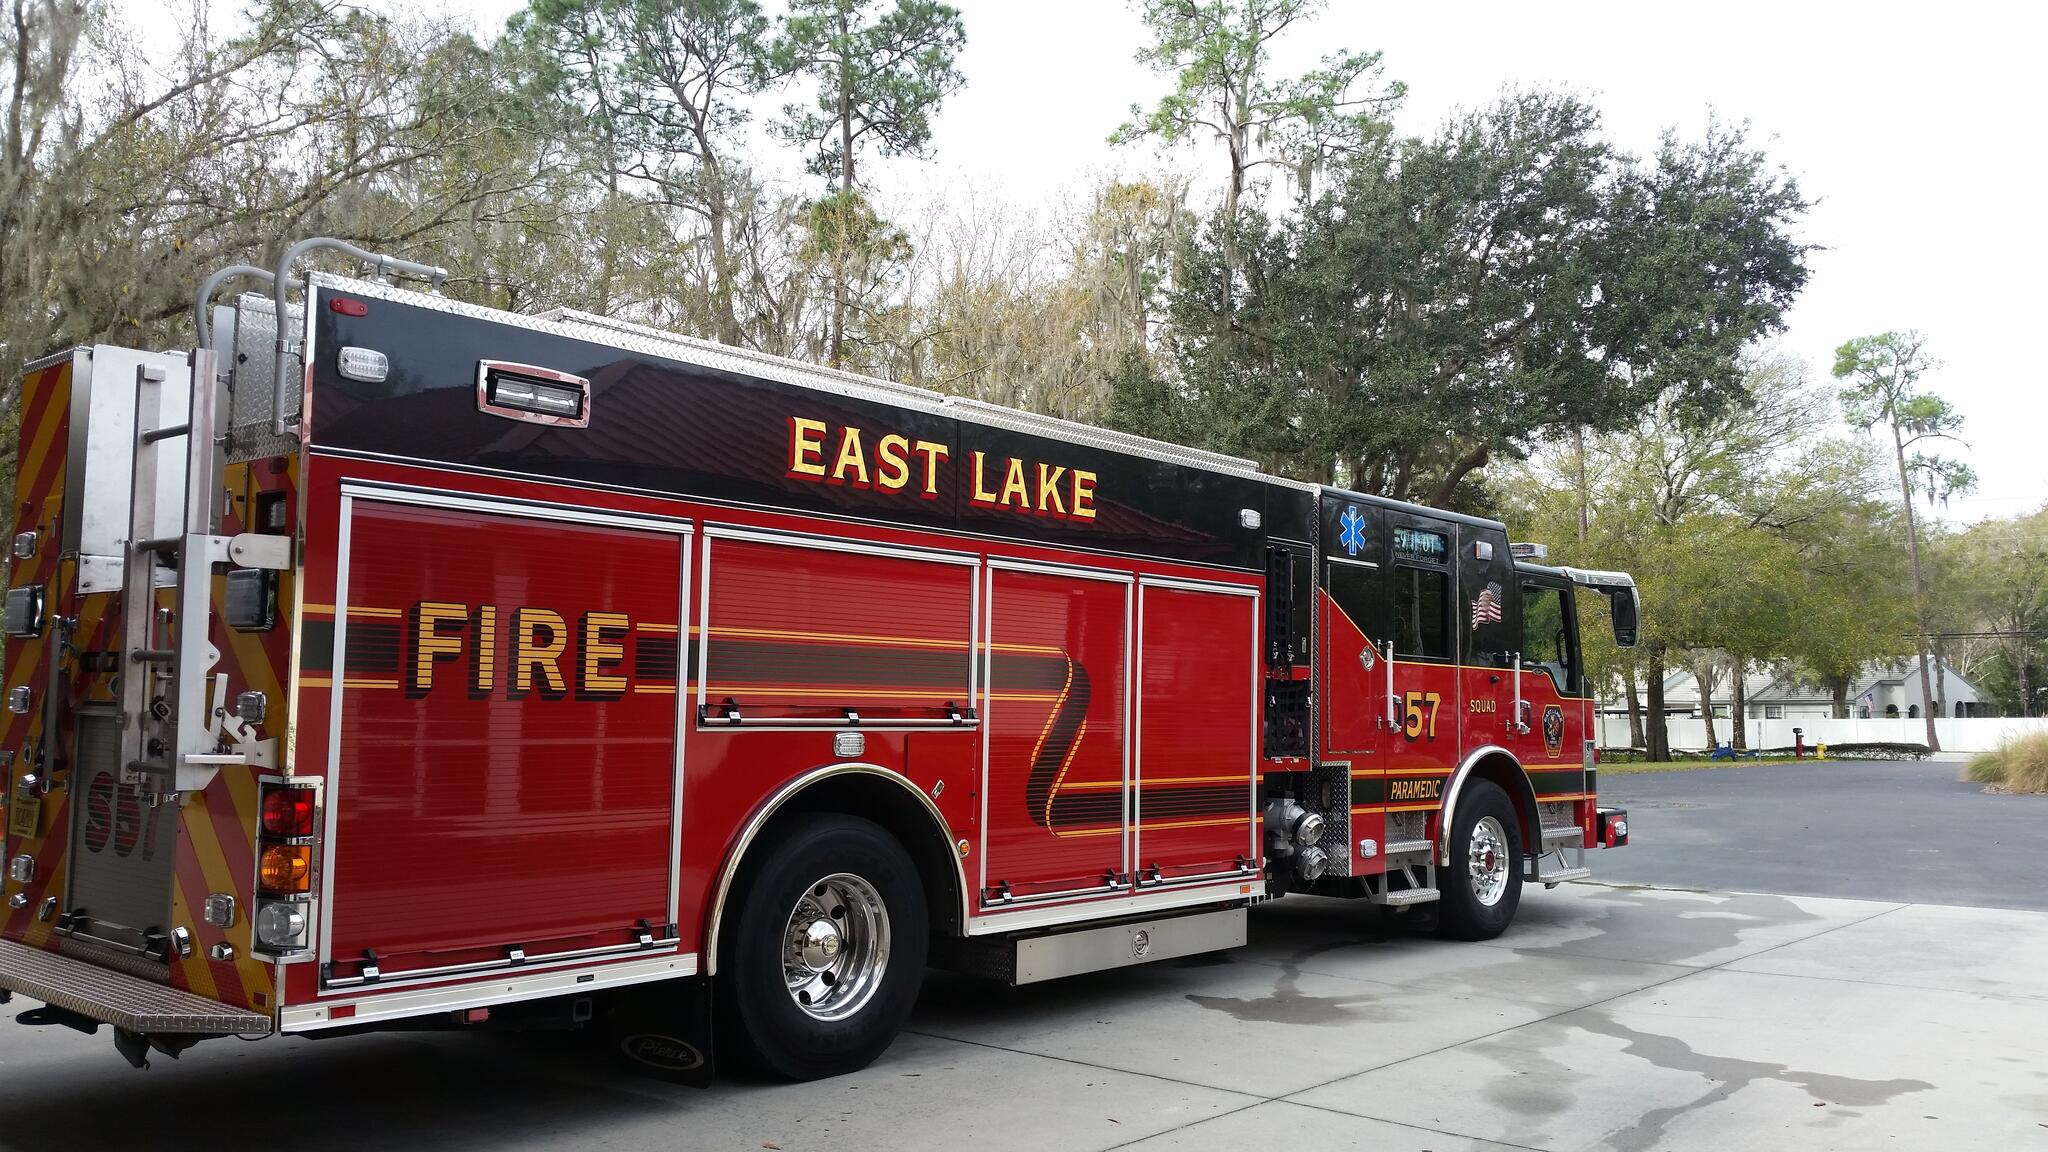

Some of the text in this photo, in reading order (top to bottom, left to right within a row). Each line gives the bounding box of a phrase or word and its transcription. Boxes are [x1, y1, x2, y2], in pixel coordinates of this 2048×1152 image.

[788, 414, 1098, 520] EAST LAKE
[411, 600, 631, 696] FIRE
[1404, 690, 1441, 742] 57
[1469, 699, 1497, 714] SQUAD
[1390, 779, 1441, 800] PARAMEDIC
[637, 1038, 690, 1062] Pierce
